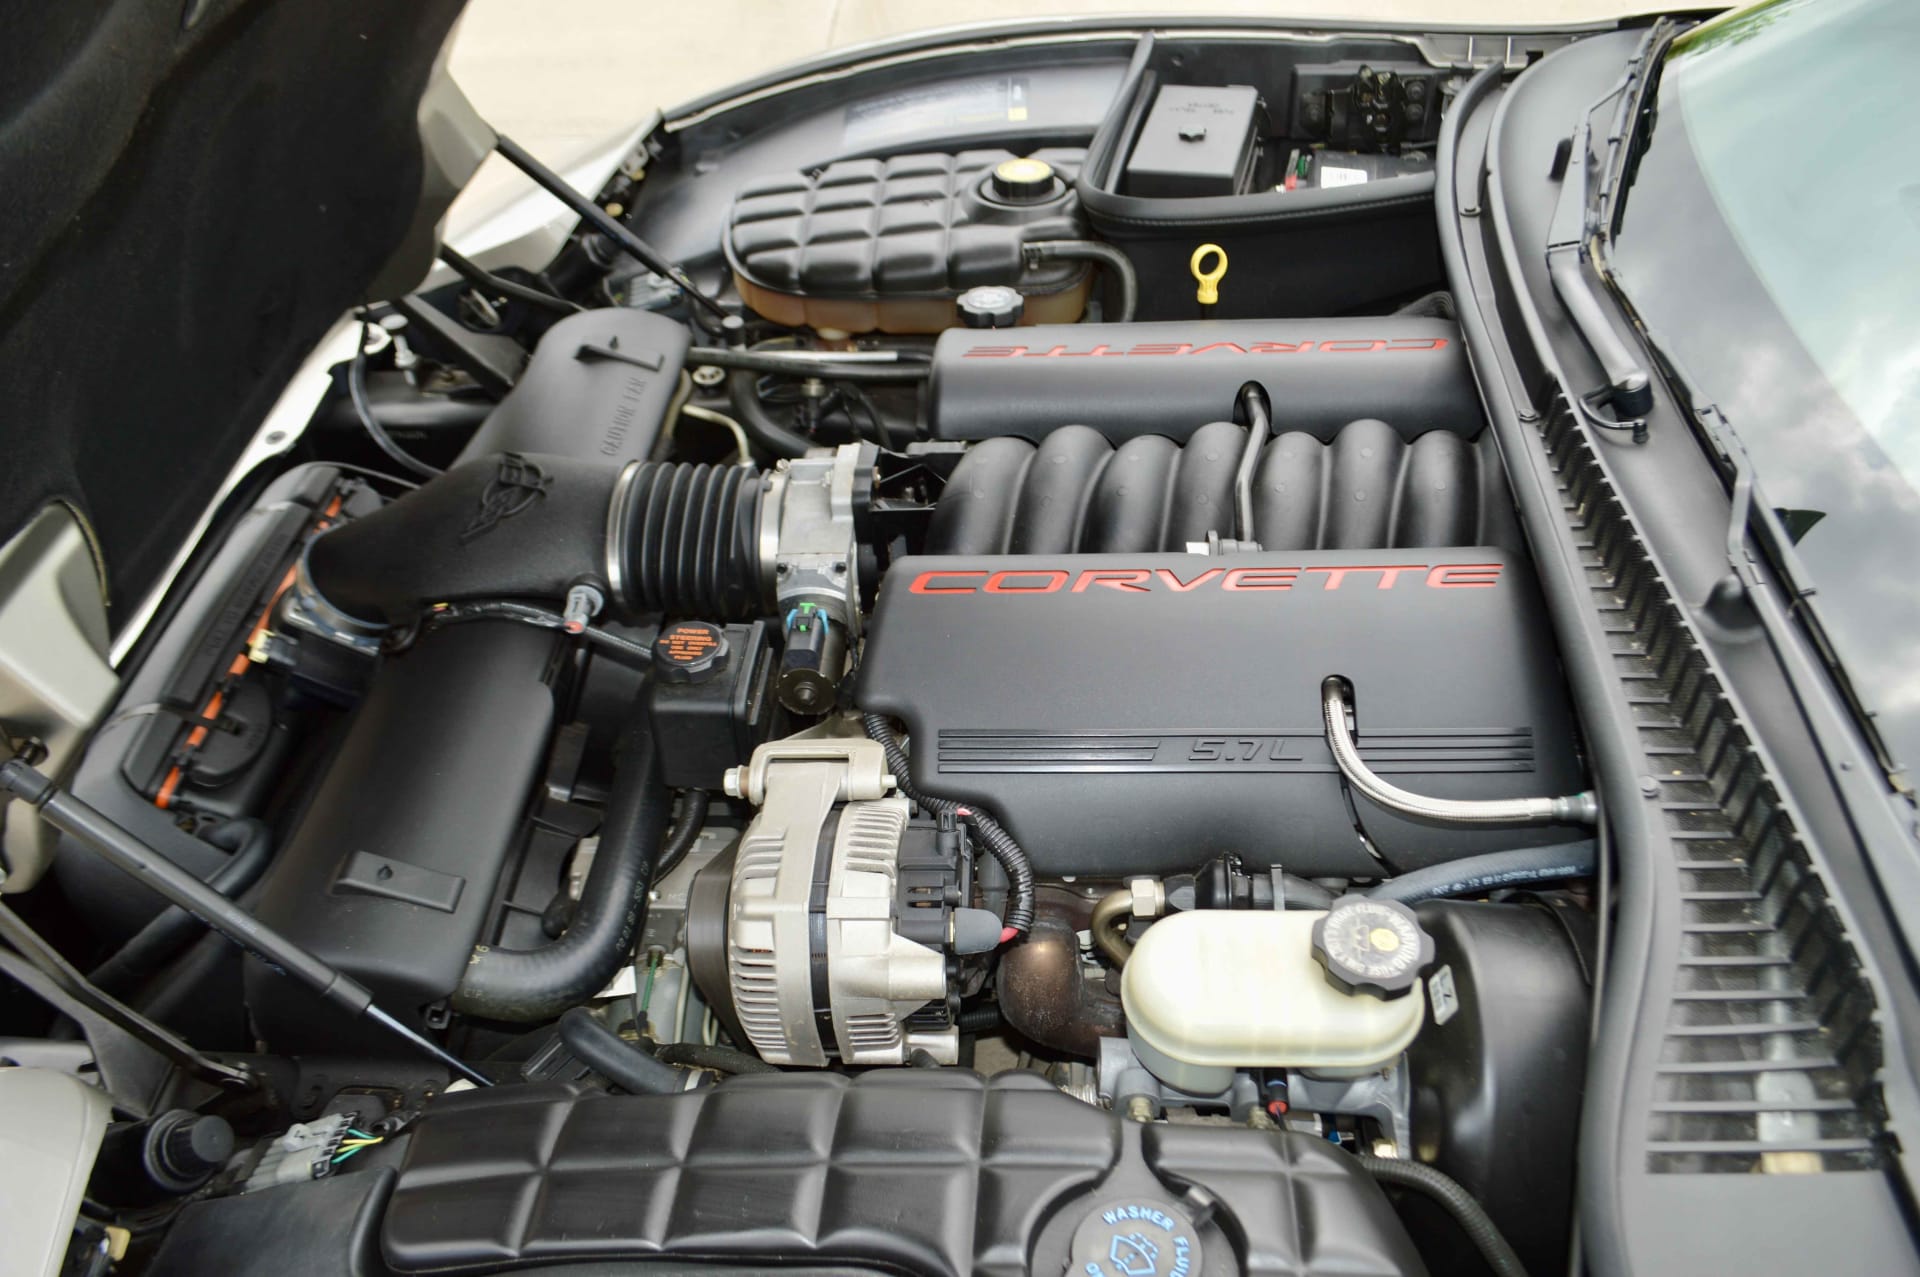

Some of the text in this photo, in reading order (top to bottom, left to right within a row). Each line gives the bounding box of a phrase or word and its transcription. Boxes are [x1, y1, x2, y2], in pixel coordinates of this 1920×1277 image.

[961, 338, 1450, 358] CORVETTE
[908, 563, 1504, 595] CORVETTE
[669, 634, 713, 642] STEERING
[1188, 737, 1304, 762] 5.7L
[1102, 1205, 1175, 1233] WASHER
